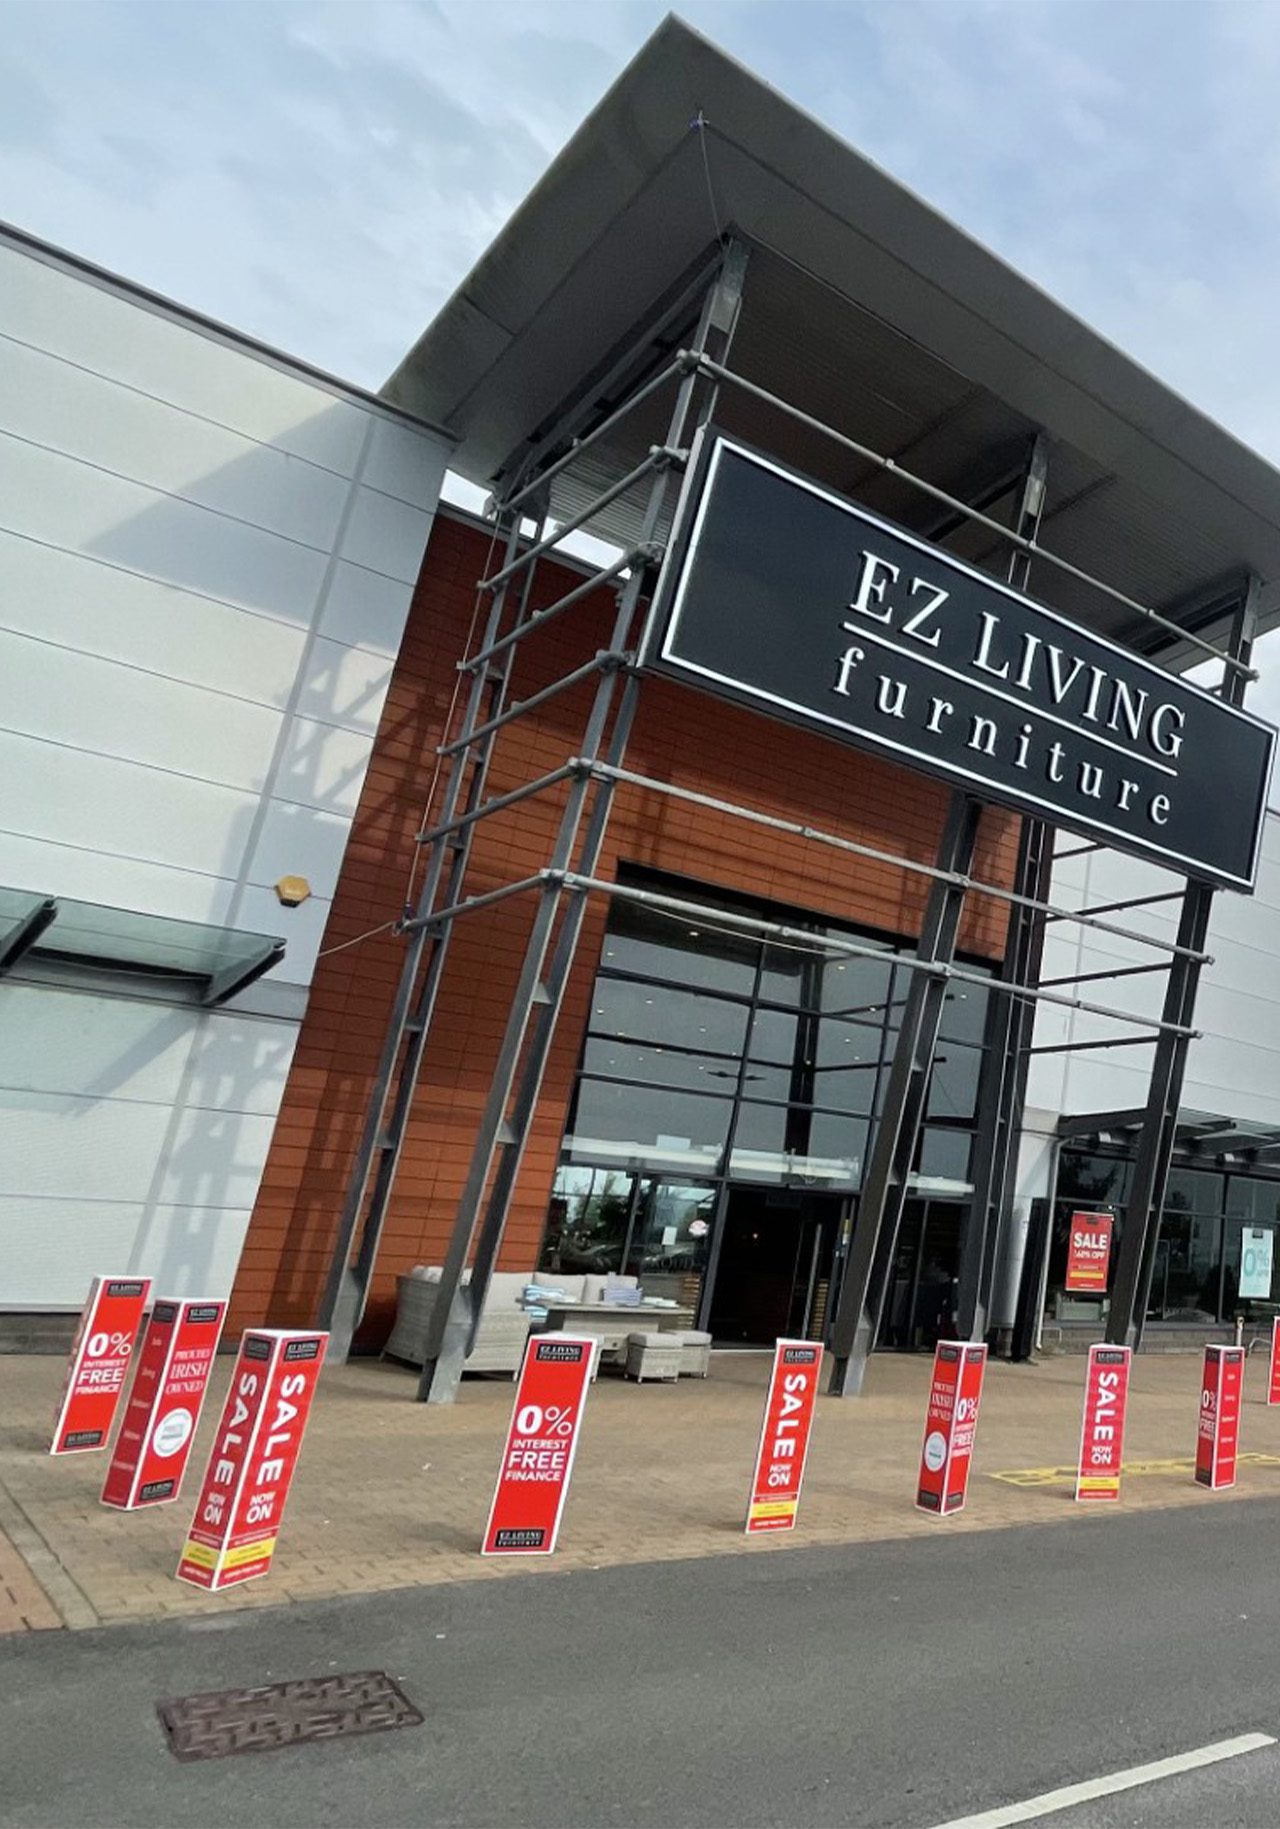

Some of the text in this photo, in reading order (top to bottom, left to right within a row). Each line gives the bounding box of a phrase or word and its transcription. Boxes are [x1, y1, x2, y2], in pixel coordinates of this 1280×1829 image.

[850, 550, 1186, 758] EZ LIVING
[833, 647, 1170, 824] furniture
[1074, 1232, 1108, 1250] SALE
[87, 1332, 132, 1357] 0%
[78, 1368, 123, 1384] FREE
[171, 1364, 207, 1379] IRISH
[773, 1374, 807, 1458] SALE
[957, 1397, 978, 1421] 0%
[1093, 1372, 1118, 1440] SALE
[214, 1372, 258, 1485] SALE
[256, 1373, 306, 1486] SALE
[517, 1405, 572, 1436] 0%
[512, 1439, 568, 1449] INTEREST
[508, 1451, 566, 1469] FREE
[1091, 1452, 1111, 1464] ON
[505, 1471, 561, 1481] FINANCE
[768, 1472, 791, 1486] ON
[204, 1504, 222, 1525] ON
[246, 1502, 273, 1524] ON
